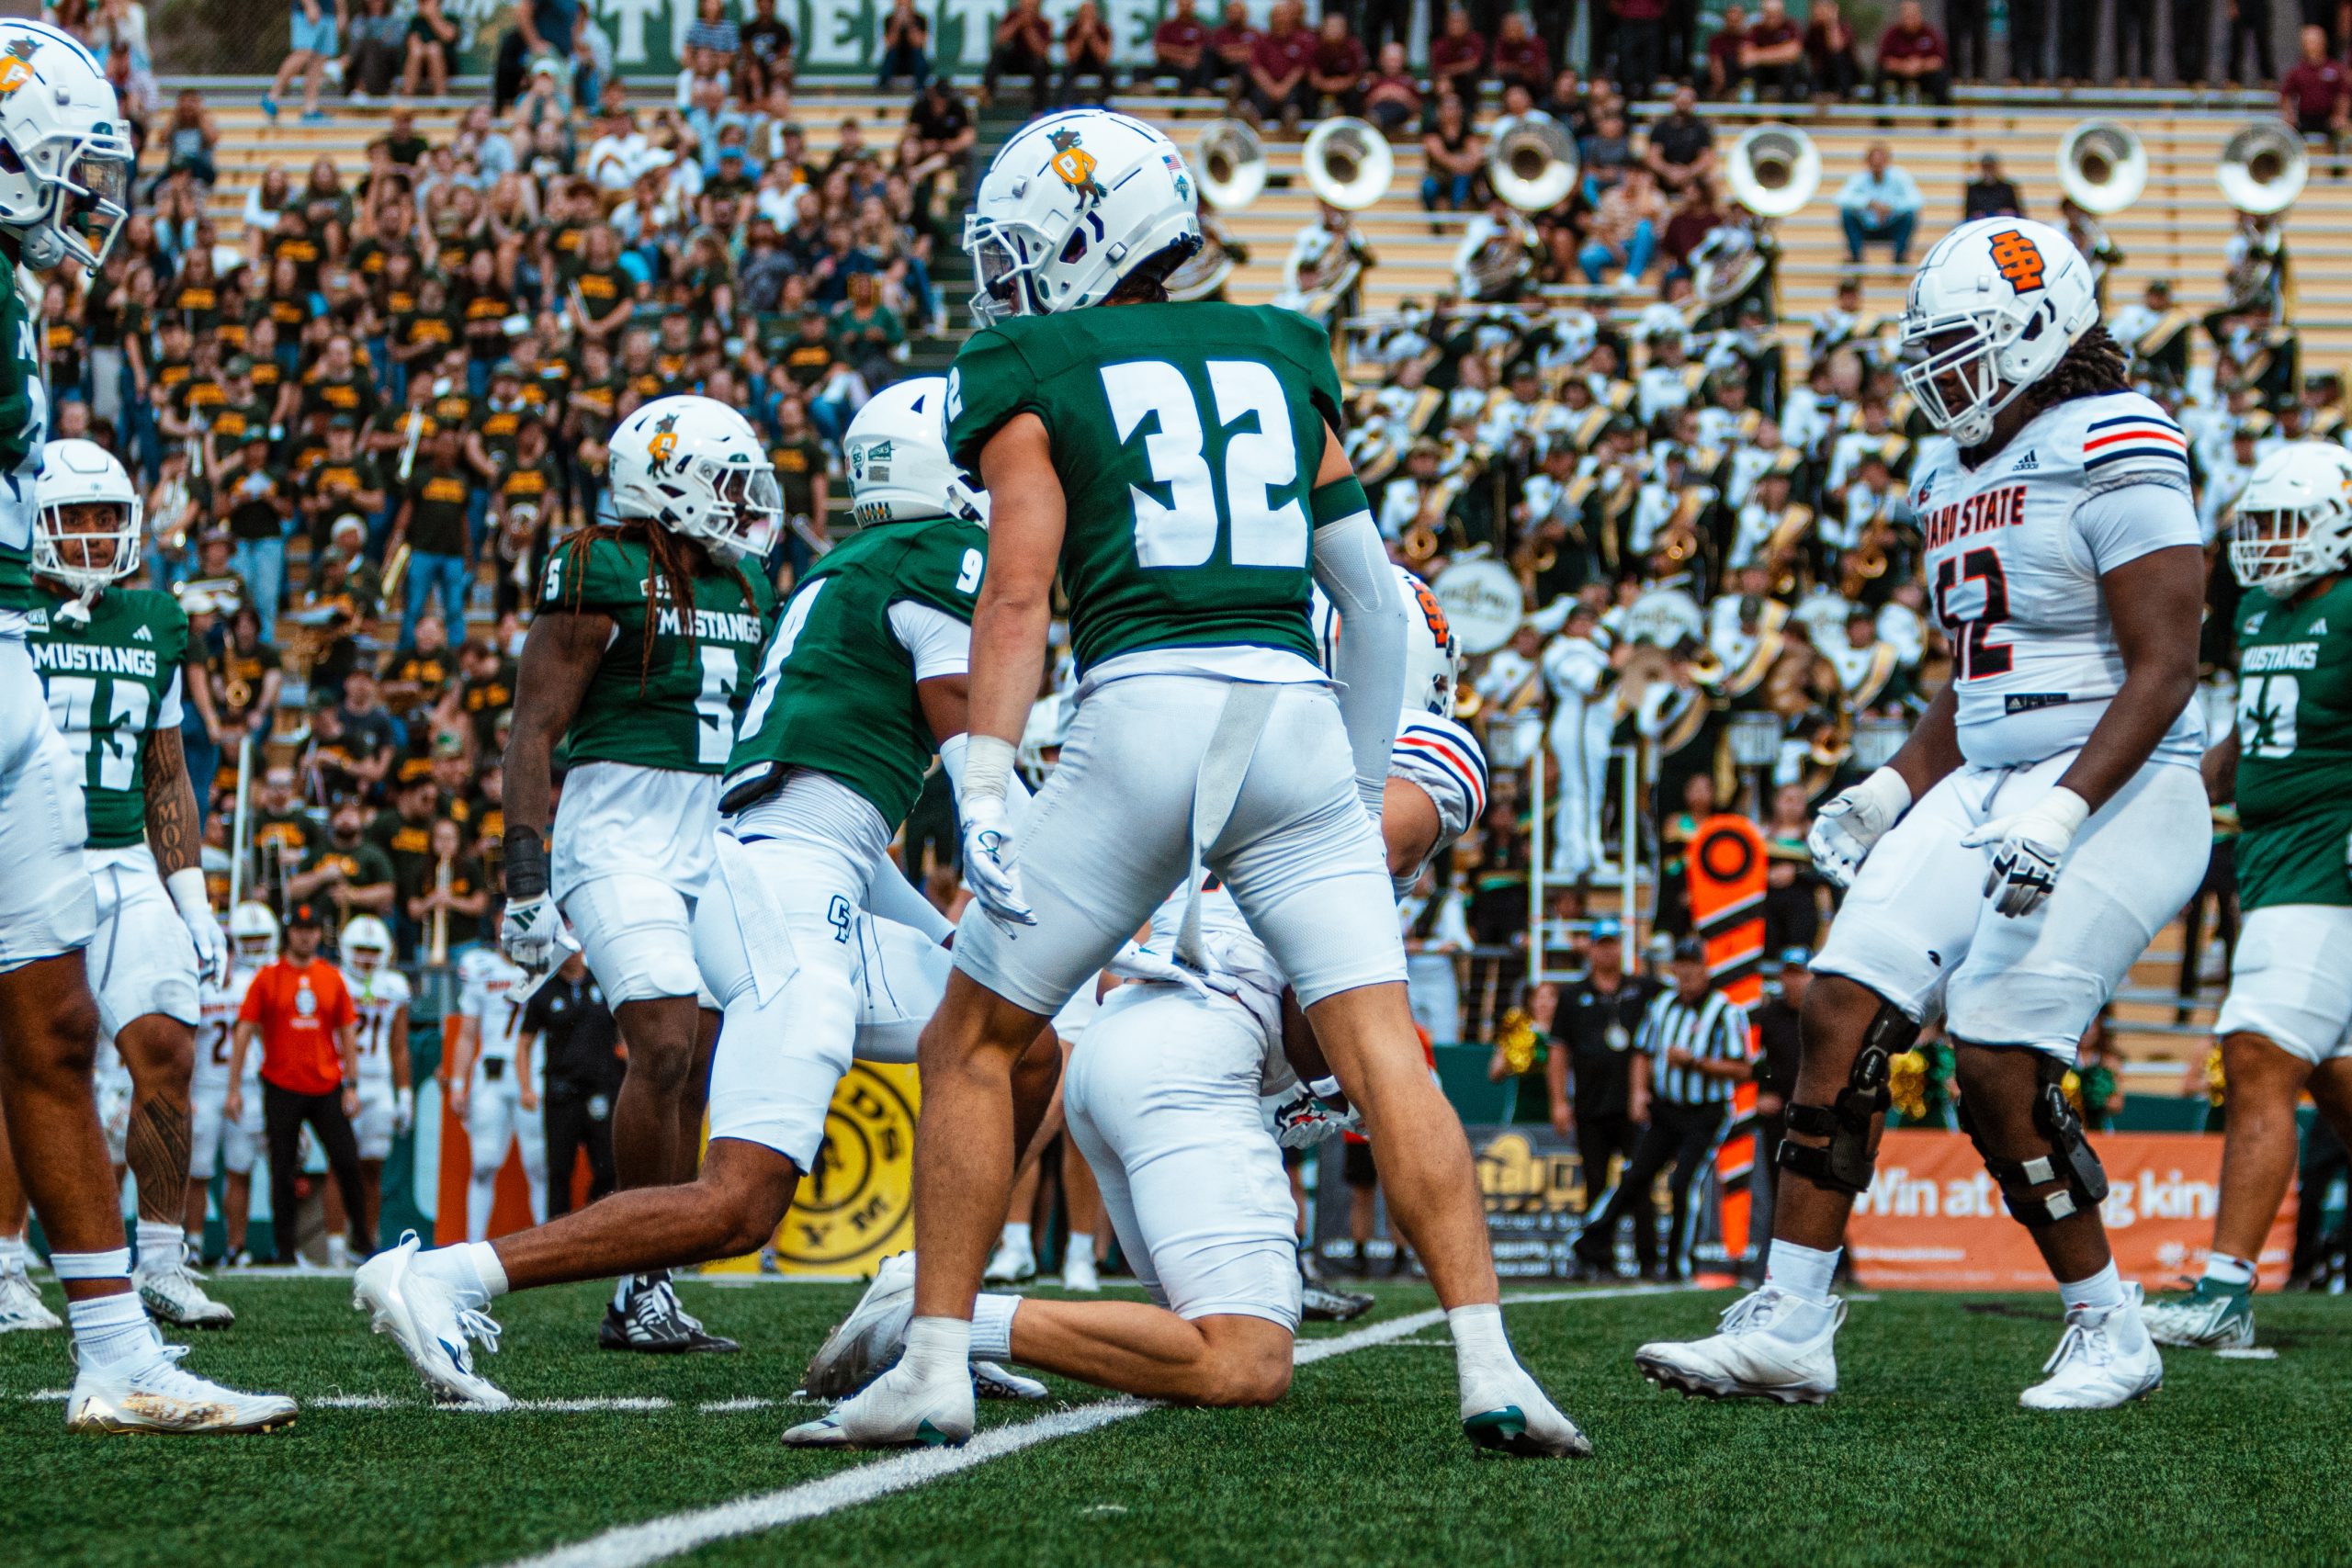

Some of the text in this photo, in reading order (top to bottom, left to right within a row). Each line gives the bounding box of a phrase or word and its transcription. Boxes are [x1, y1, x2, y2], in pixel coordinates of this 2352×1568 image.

[1058, 153, 1079, 179] P
[1100, 360, 1308, 569] 32
[1959, 484, 2027, 538] STATE
[546, 558, 562, 601] 5
[956, 547, 984, 594] 9
[32, 642, 156, 678] MUSTANGS
[2240, 642, 2320, 672] MUSTANGS
[694, 645, 739, 764] 5
[211, 1019, 230, 1066] 2
[1852, 1166, 1939, 1218] Win
[1945, 1168, 1995, 1218] at
[2139, 1167, 2221, 1220] kin
[799, 1195, 890, 1247] YM
